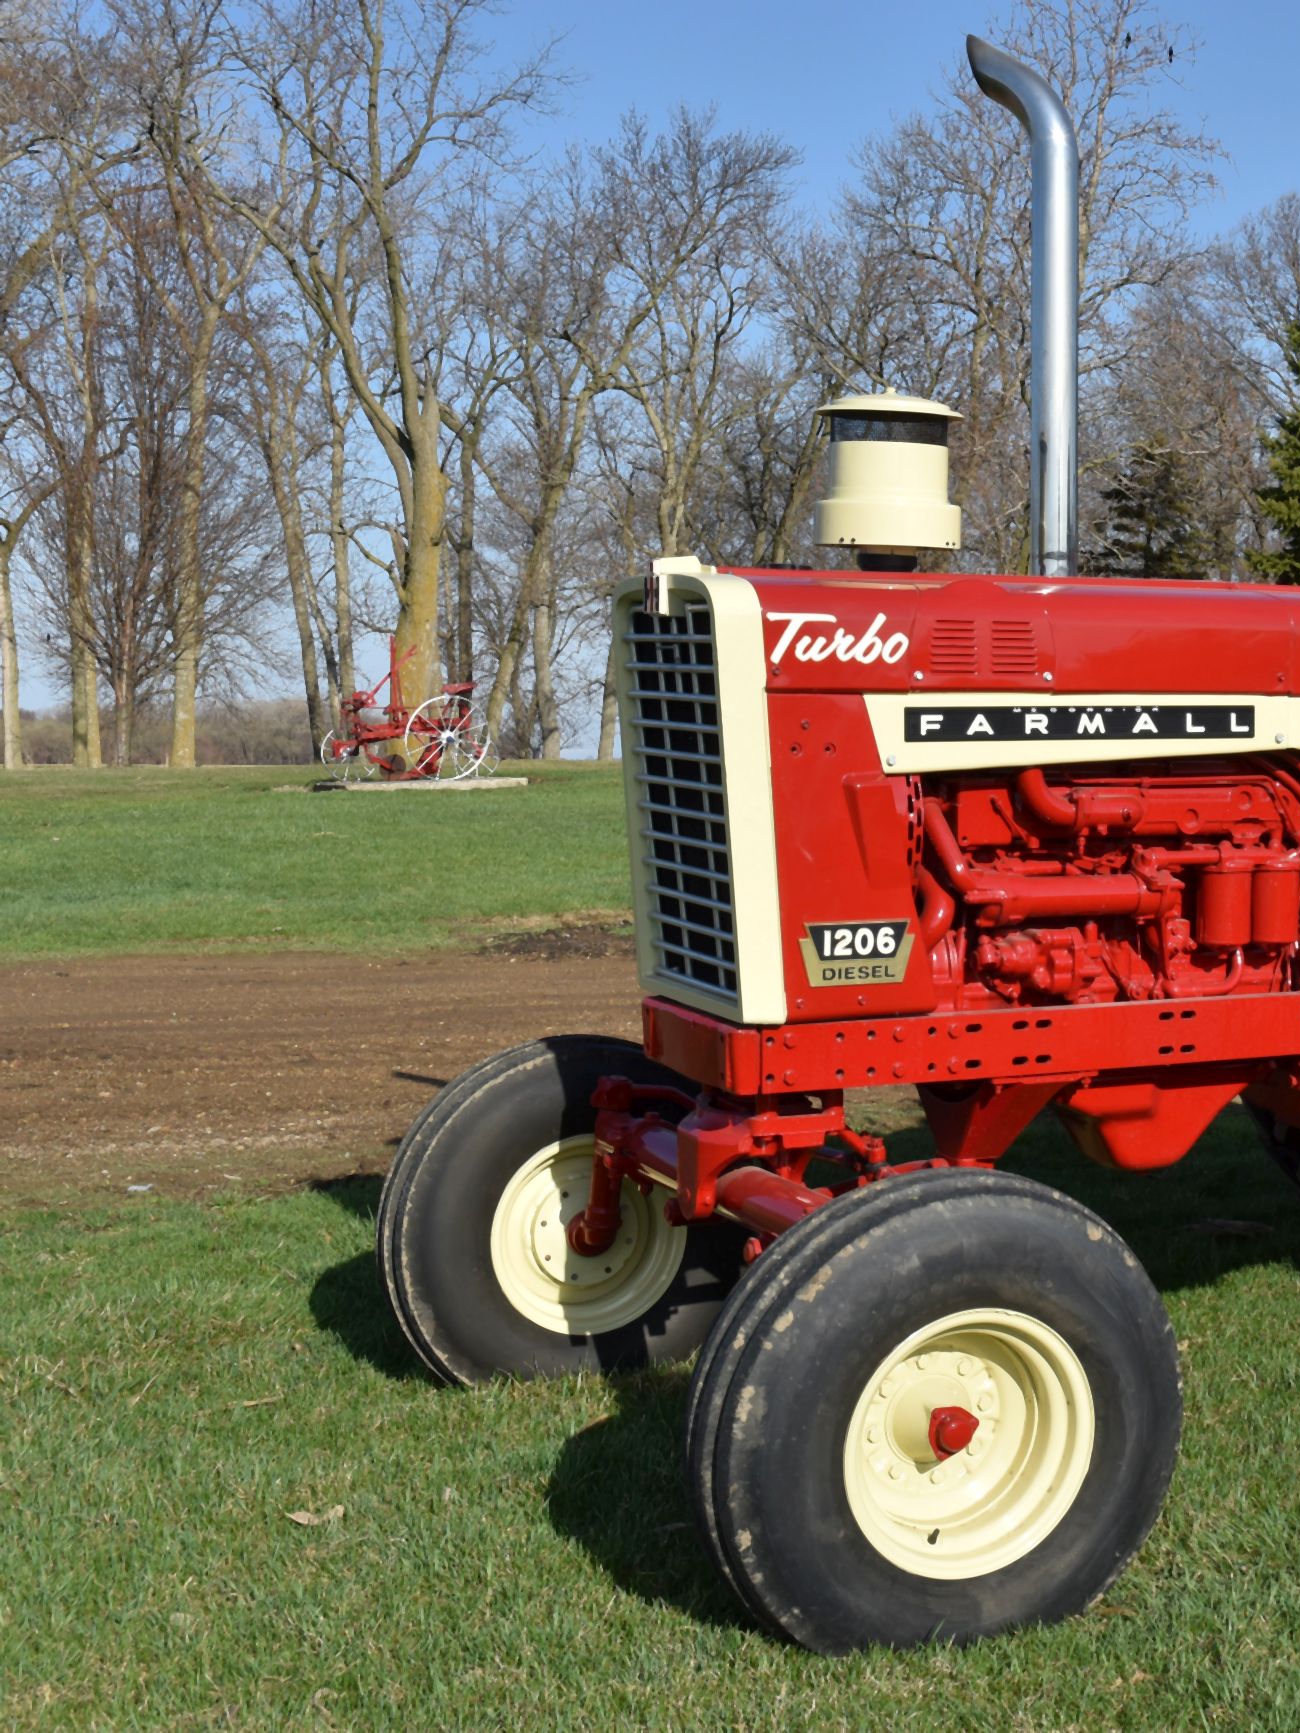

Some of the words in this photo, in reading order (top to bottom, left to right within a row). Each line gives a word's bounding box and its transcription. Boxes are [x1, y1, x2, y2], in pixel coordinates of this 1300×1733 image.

[765, 612, 909, 664] Turbo
[920, 714, 1250, 736] FARMALL
[824, 926, 896, 957] 1206
[822, 965, 895, 981] DIESEL
